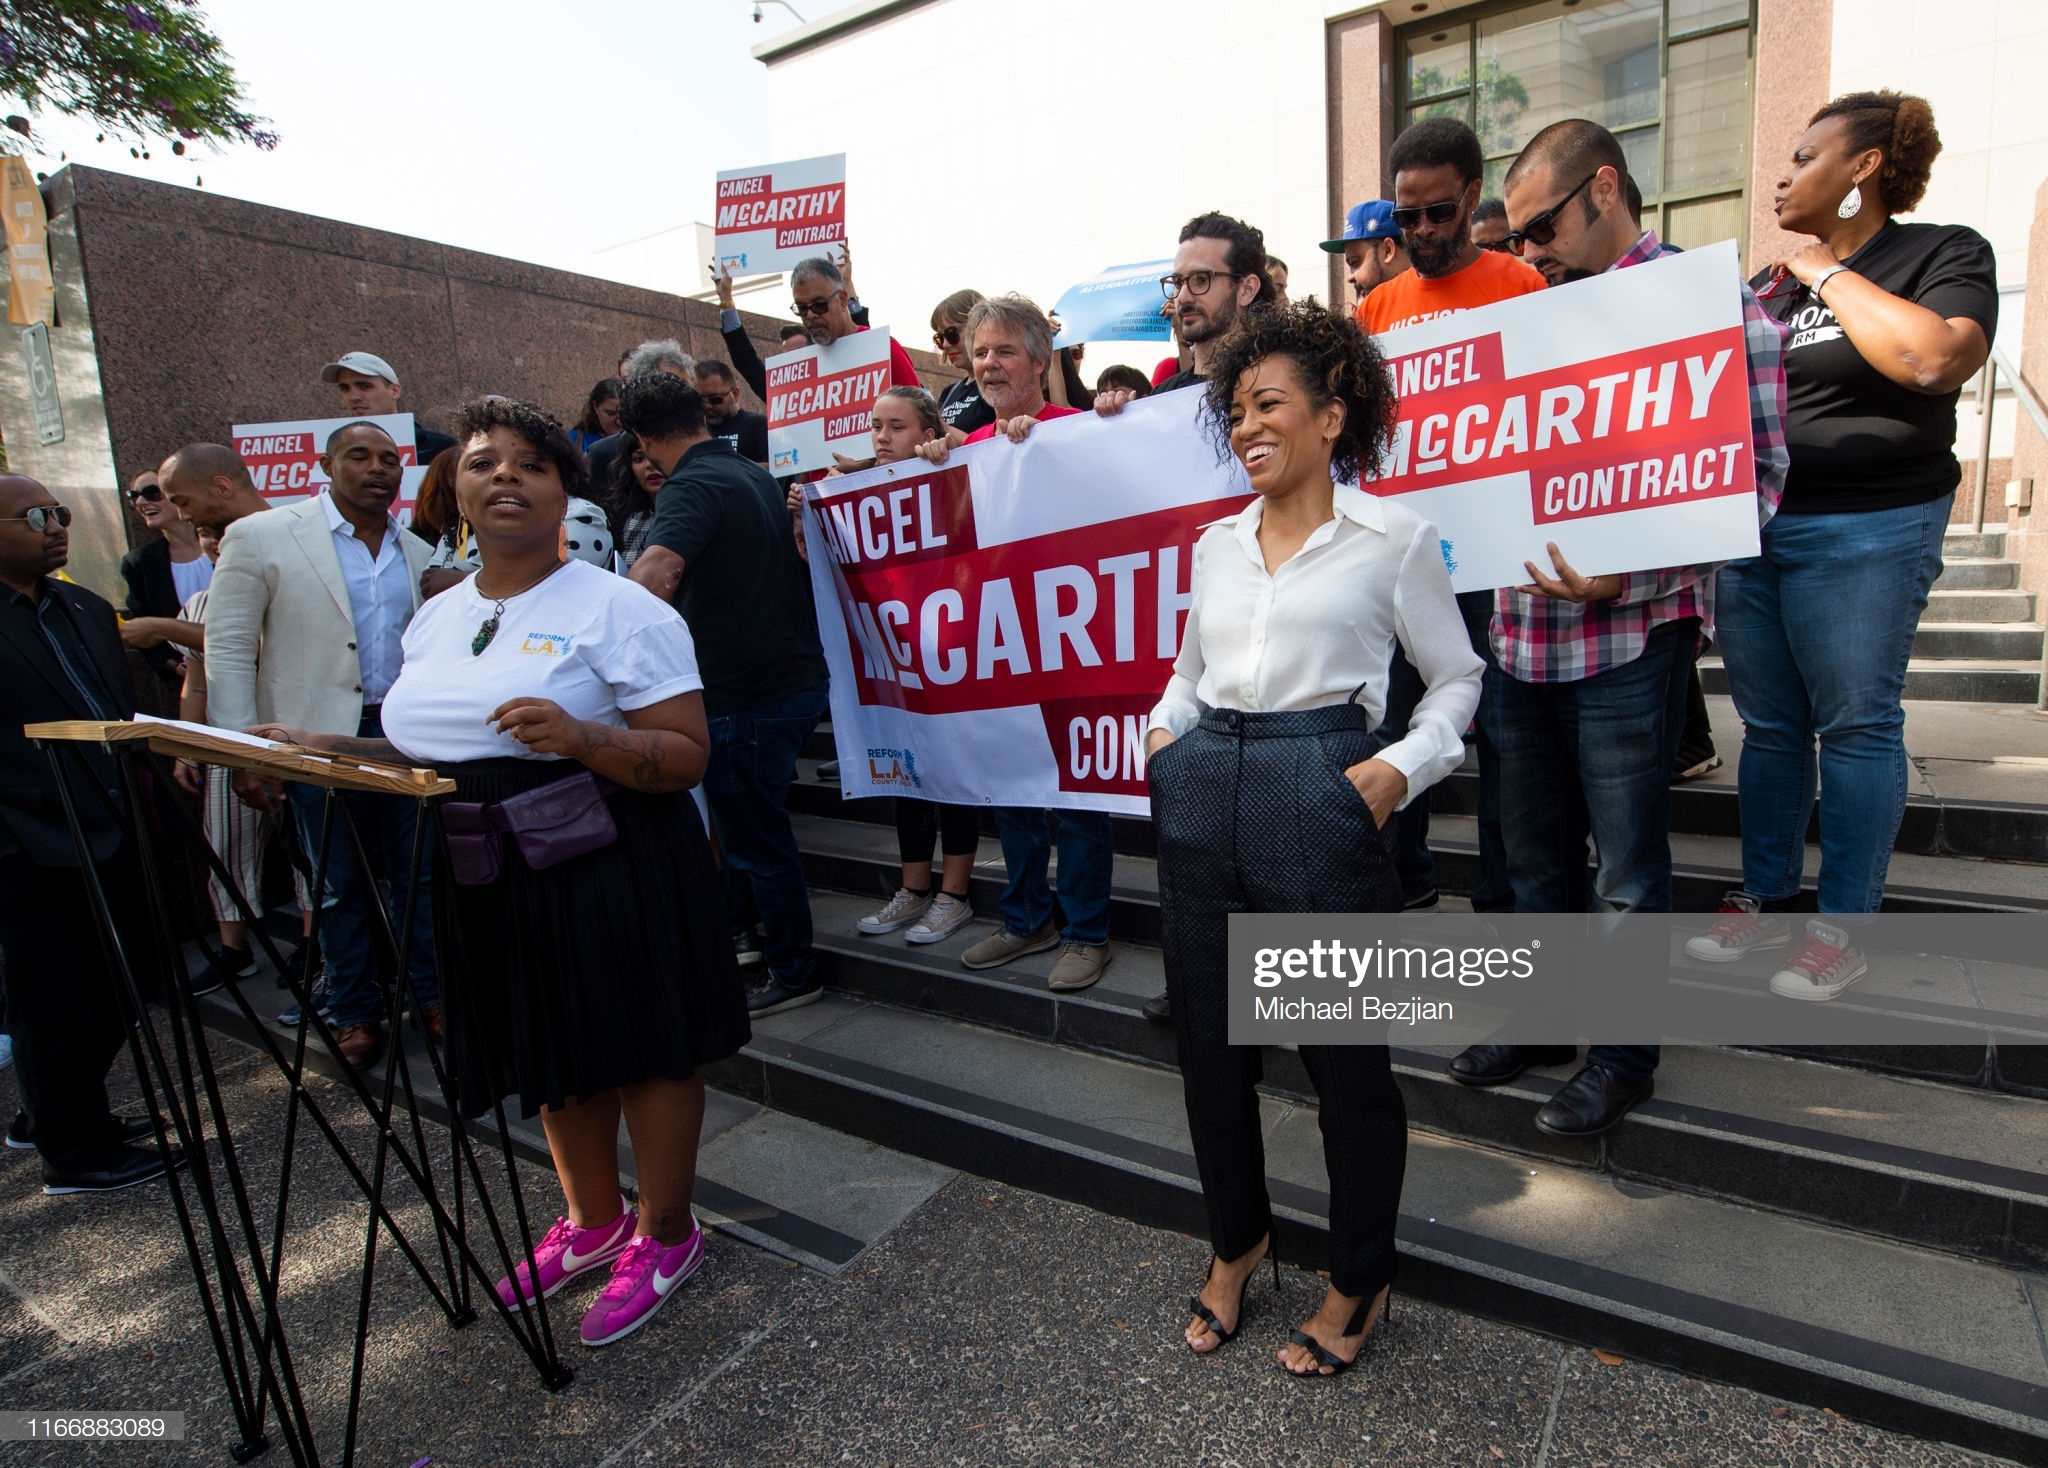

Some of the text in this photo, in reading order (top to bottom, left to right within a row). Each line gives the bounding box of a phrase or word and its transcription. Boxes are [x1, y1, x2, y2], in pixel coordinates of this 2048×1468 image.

[719, 177, 764, 198] CANCEL
[779, 222, 843, 247] CONTRACT
[769, 361, 810, 388] CANCEL
[1385, 343, 1481, 399] ANCEL
[827, 411, 873, 438] CONTRA
[240, 435, 304, 457] CANCEL
[1544, 441, 1744, 516] CONTRACT
[850, 542, 1198, 690] McCARTH
[520, 638, 559, 654] L.A.
[527, 632, 566, 643] REFORM
[867, 748, 903, 760] REFORM
[868, 759, 910, 781] L.A.
